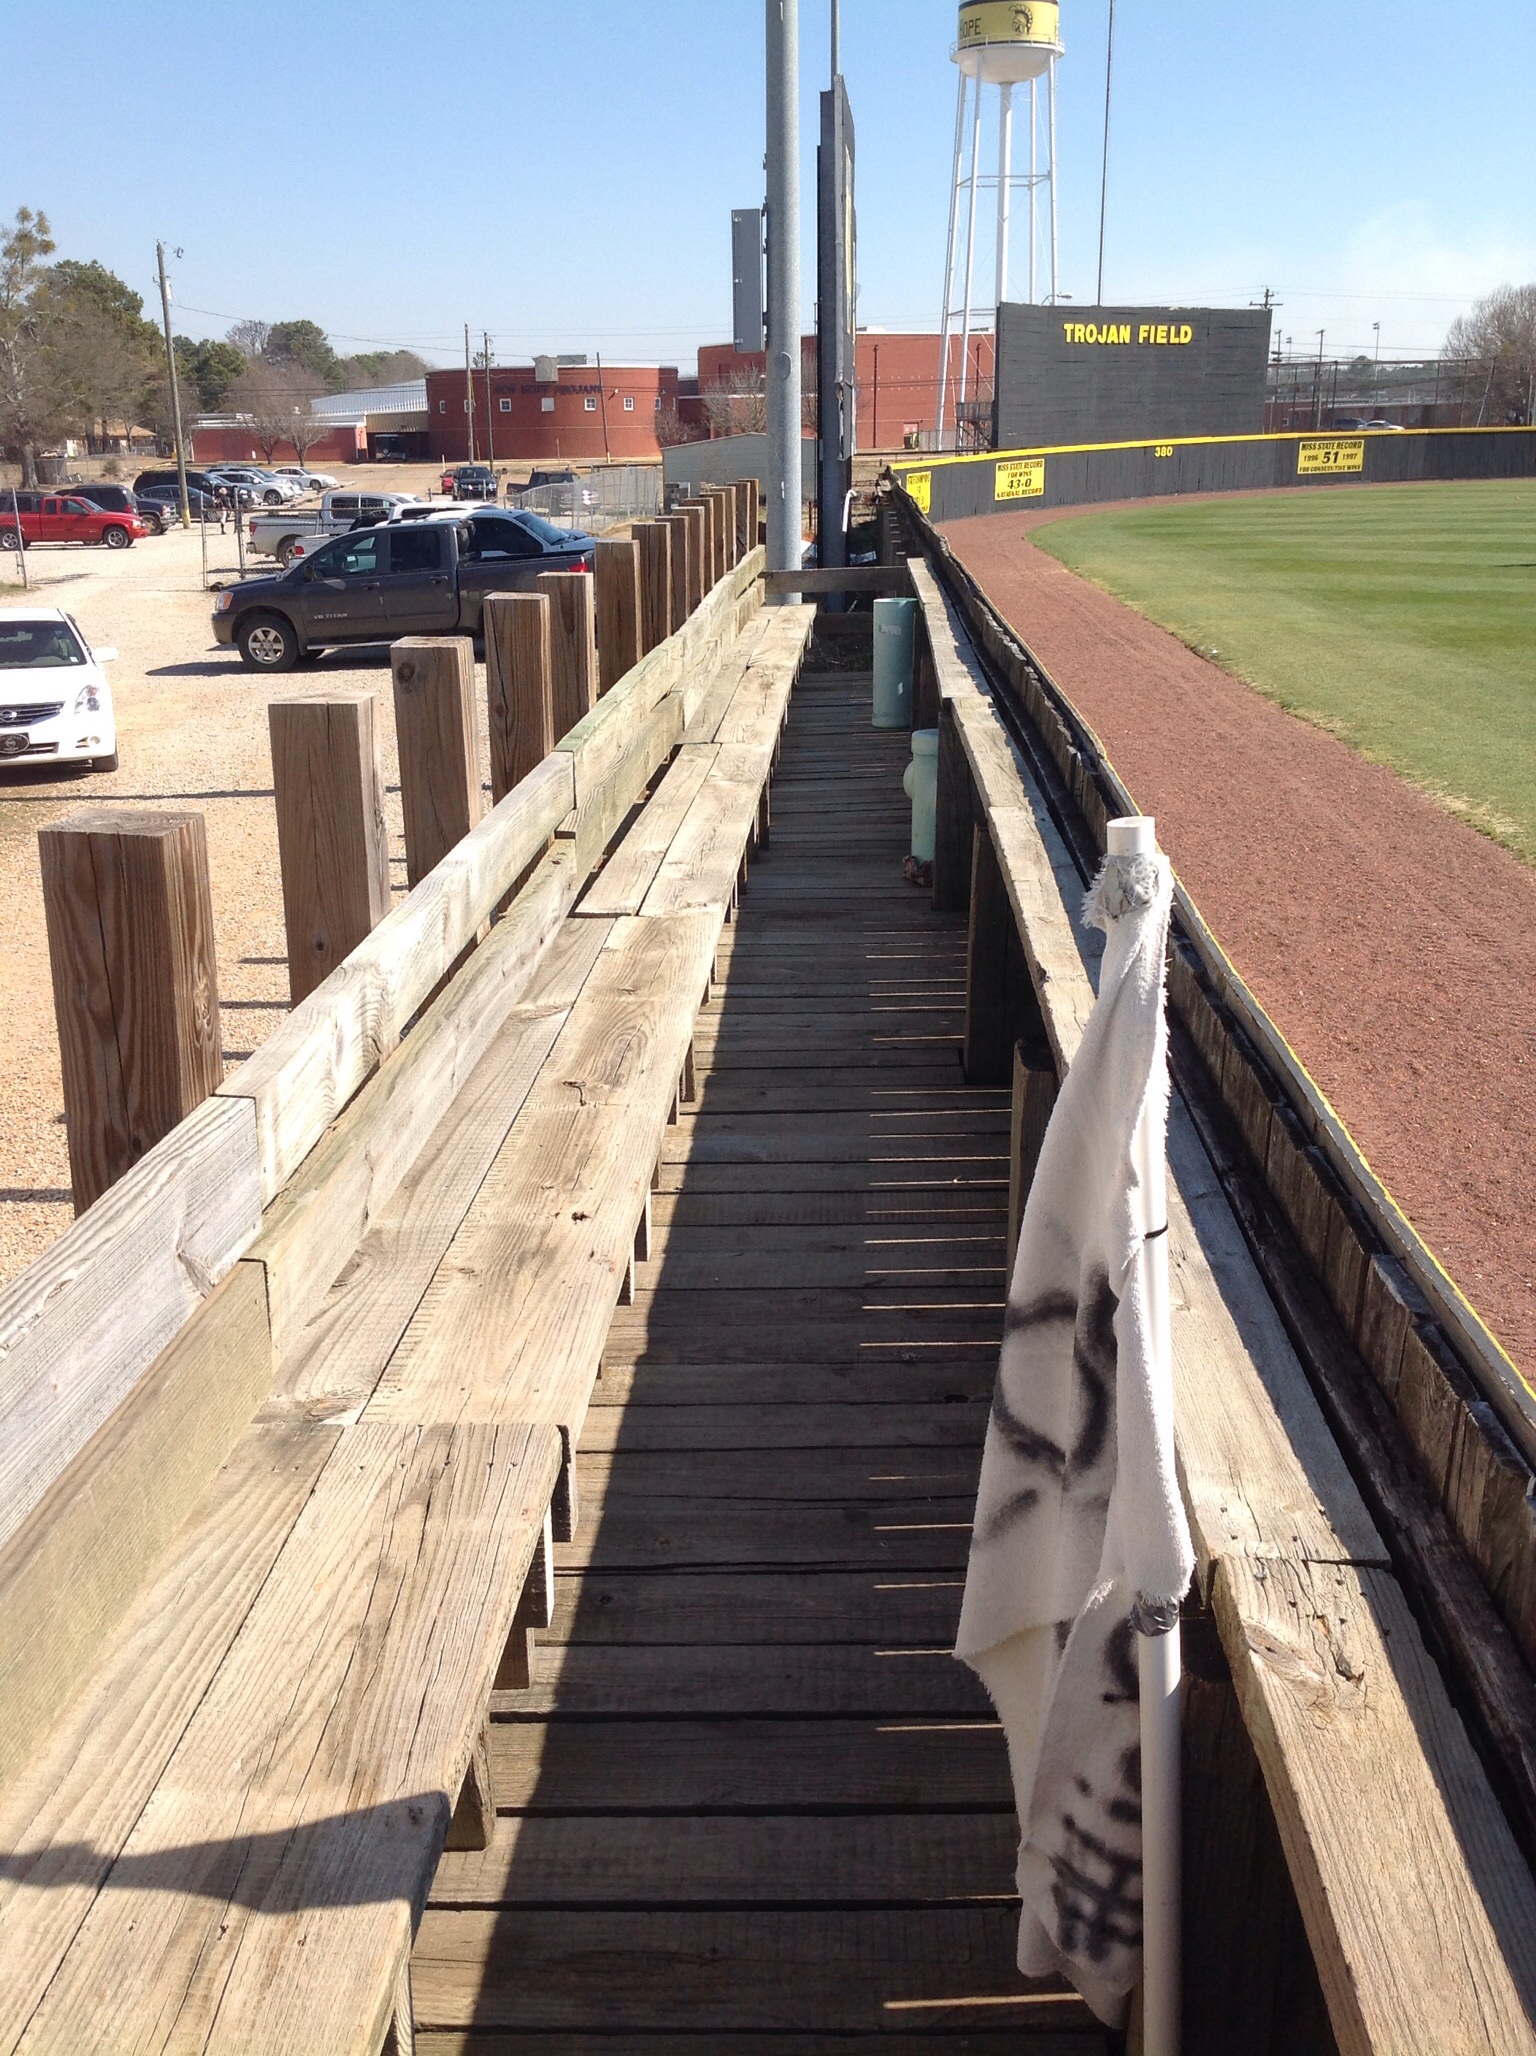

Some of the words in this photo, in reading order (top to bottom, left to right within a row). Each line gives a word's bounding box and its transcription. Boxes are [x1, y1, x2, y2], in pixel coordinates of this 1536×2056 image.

[1063, 323, 1131, 344] TROJAN
[1138, 324, 1192, 344] FIELD
[1154, 446, 1173, 457] 380
[1301, 443, 1316, 451] MISS
[1317, 442, 1335, 450] STATE
[1336, 441, 1362, 450] RECORD
[1322, 451, 1339, 464] 51
[1023, 460, 1043, 469] RECORD
[1007, 478, 1032, 489] 43-0
[1021, 487, 1042, 496] RECORD
